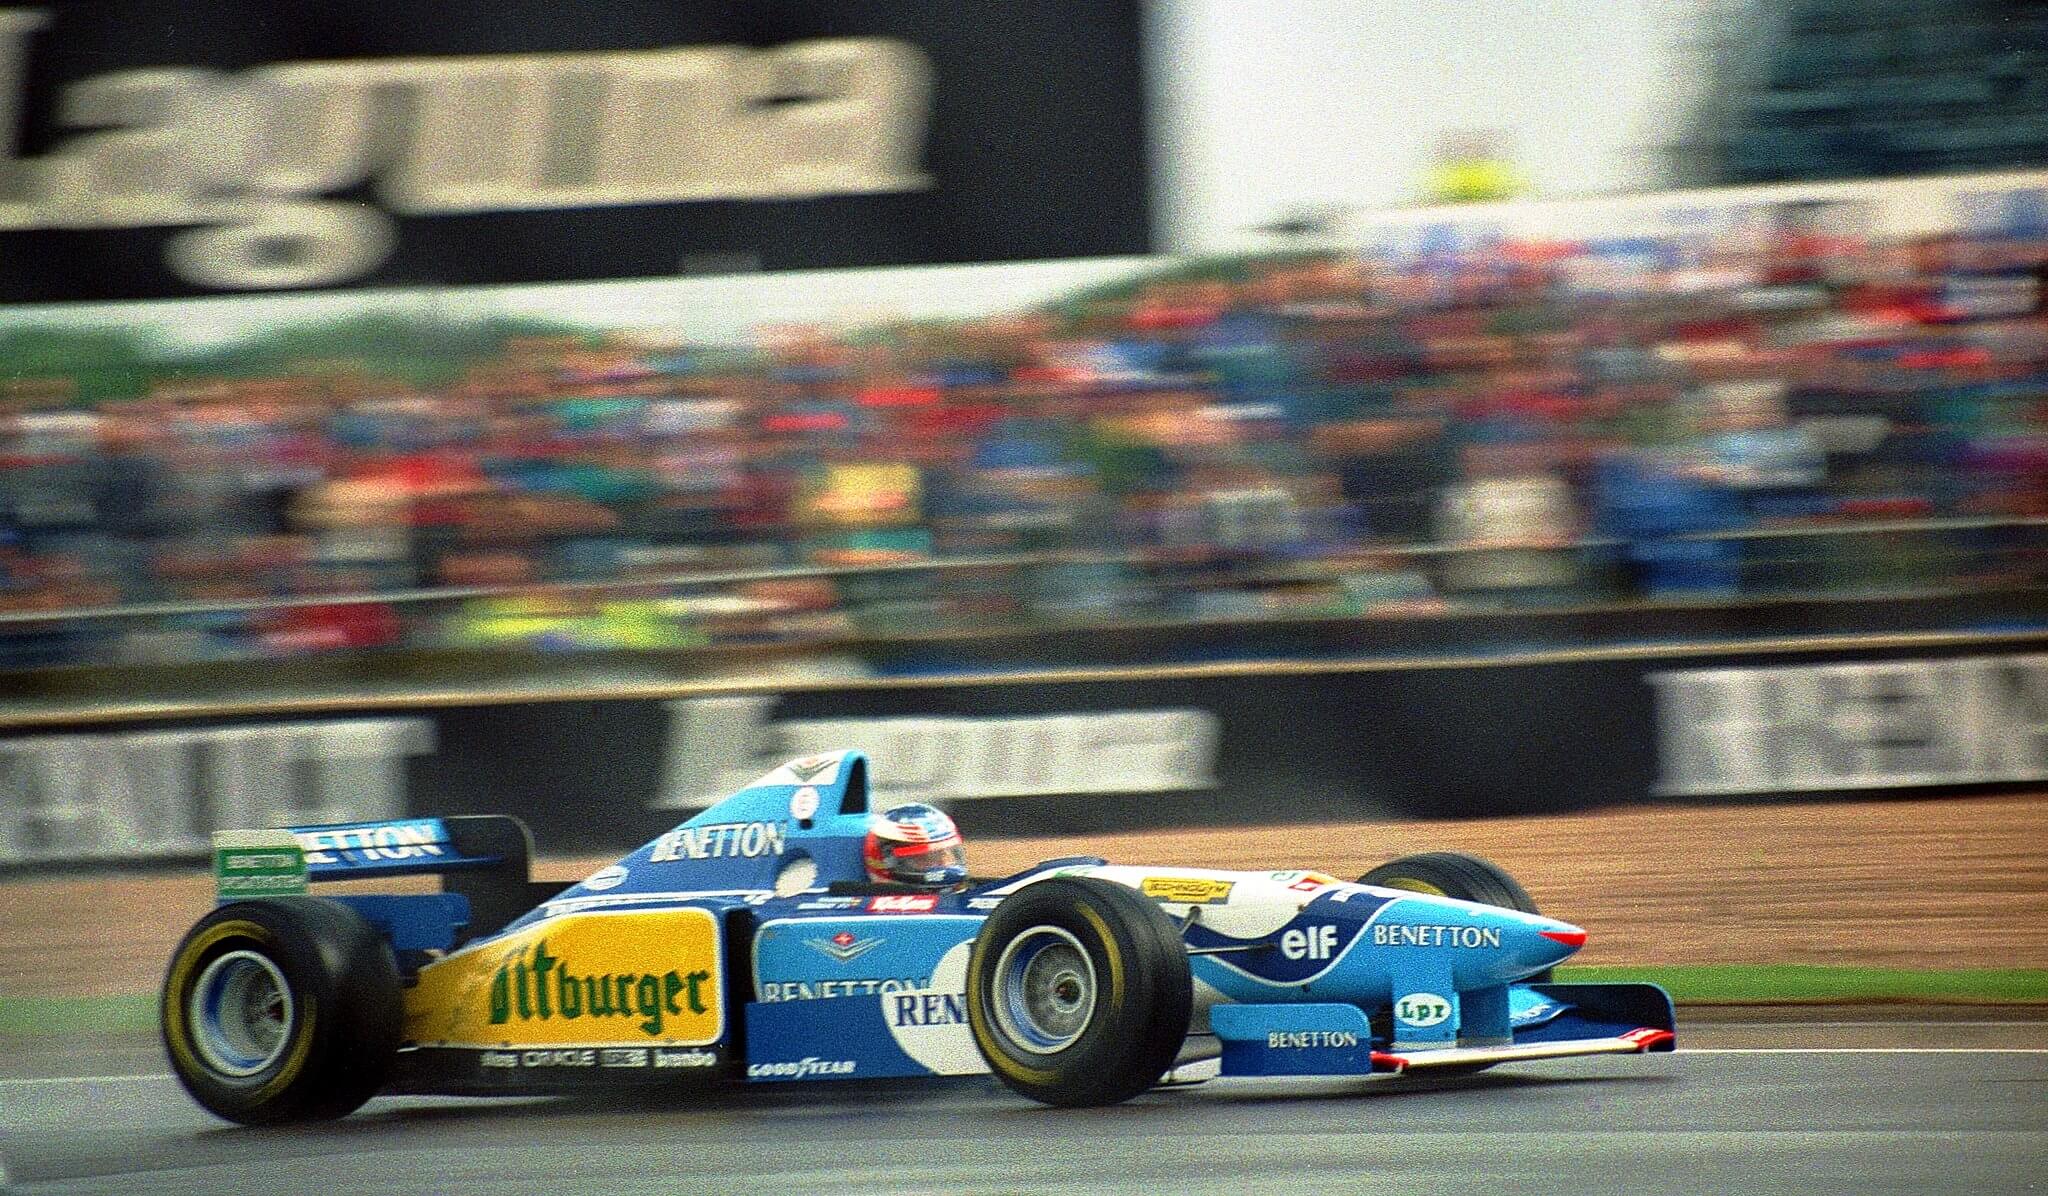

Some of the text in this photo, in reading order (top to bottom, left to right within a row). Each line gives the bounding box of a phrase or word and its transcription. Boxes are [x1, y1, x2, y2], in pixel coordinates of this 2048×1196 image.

[650, 821, 787, 863] BENETTON
[1281, 924, 1339, 960] elf
[1374, 924, 1501, 948] BENETTON
[1268, 1031, 1358, 1049] BENETTON
